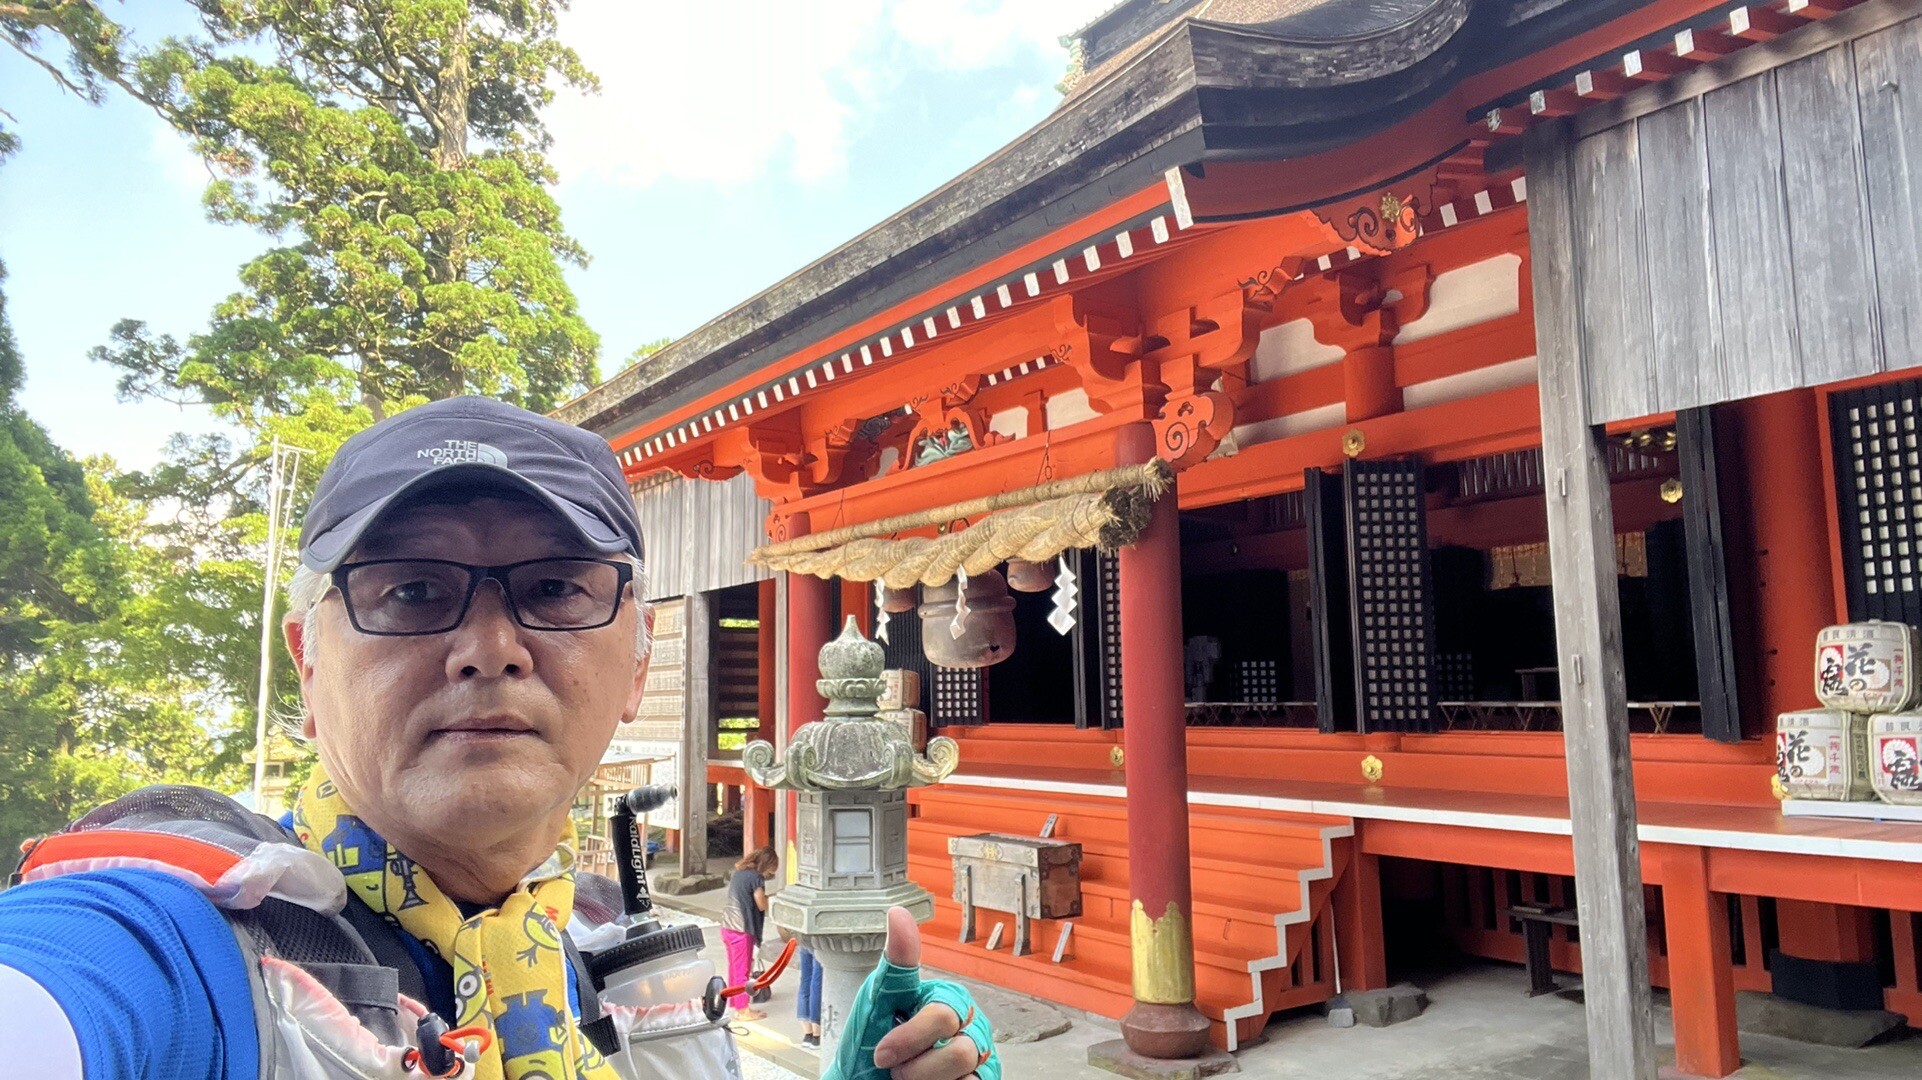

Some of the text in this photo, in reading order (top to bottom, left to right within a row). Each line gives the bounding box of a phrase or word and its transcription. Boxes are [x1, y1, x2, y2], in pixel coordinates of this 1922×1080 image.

[445, 439, 478, 450] THE
[417, 448, 477, 458] NORTH
[433, 456, 477, 465] FACE
[1844, 642, 1876, 691] 花の
[1787, 730, 1810, 777] 花の
